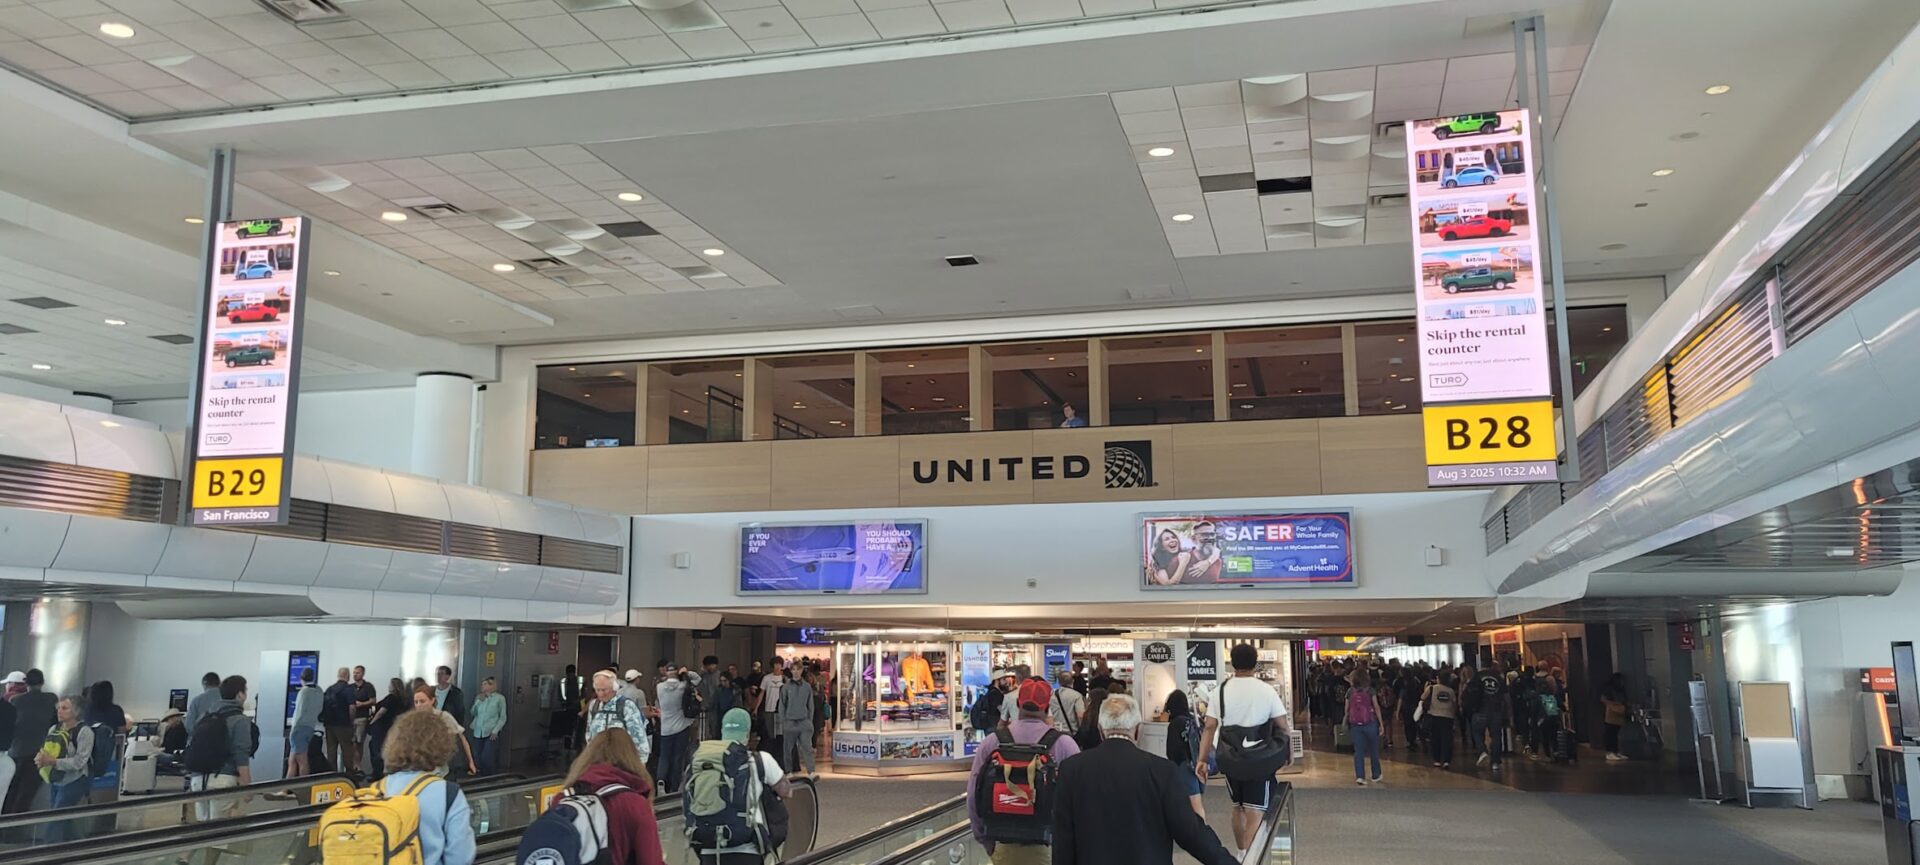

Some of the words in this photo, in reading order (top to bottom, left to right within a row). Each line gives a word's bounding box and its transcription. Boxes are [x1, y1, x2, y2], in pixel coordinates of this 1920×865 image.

[1427, 329, 1456, 342] Skip
[1460, 328, 1481, 338] the
[1485, 325, 1526, 337] rental
[1428, 345, 1480, 355] counter
[1434, 376, 1462, 384] TURO
[209, 397, 229, 407] Skip
[231, 396, 246, 405] the
[248, 395, 276, 404] rental
[208, 410, 244, 418] counter
[1446, 416, 1531, 450] B28
[913, 455, 1090, 483] UNITED
[1437, 470, 1458, 481] Aug
[1461, 469, 1467, 478] 3
[1470, 469, 1495, 478] 2025
[1500, 467, 1525, 476] 10:32
[1529, 466, 1547, 475] AM
[208, 469, 265, 496] B29
[203, 511, 221, 521] San
[224, 509, 269, 520] Francisco
[1225, 525, 1291, 541] SAFER
[1150, 645, 1166, 653] See's
[1191, 657, 1211, 666] See's
